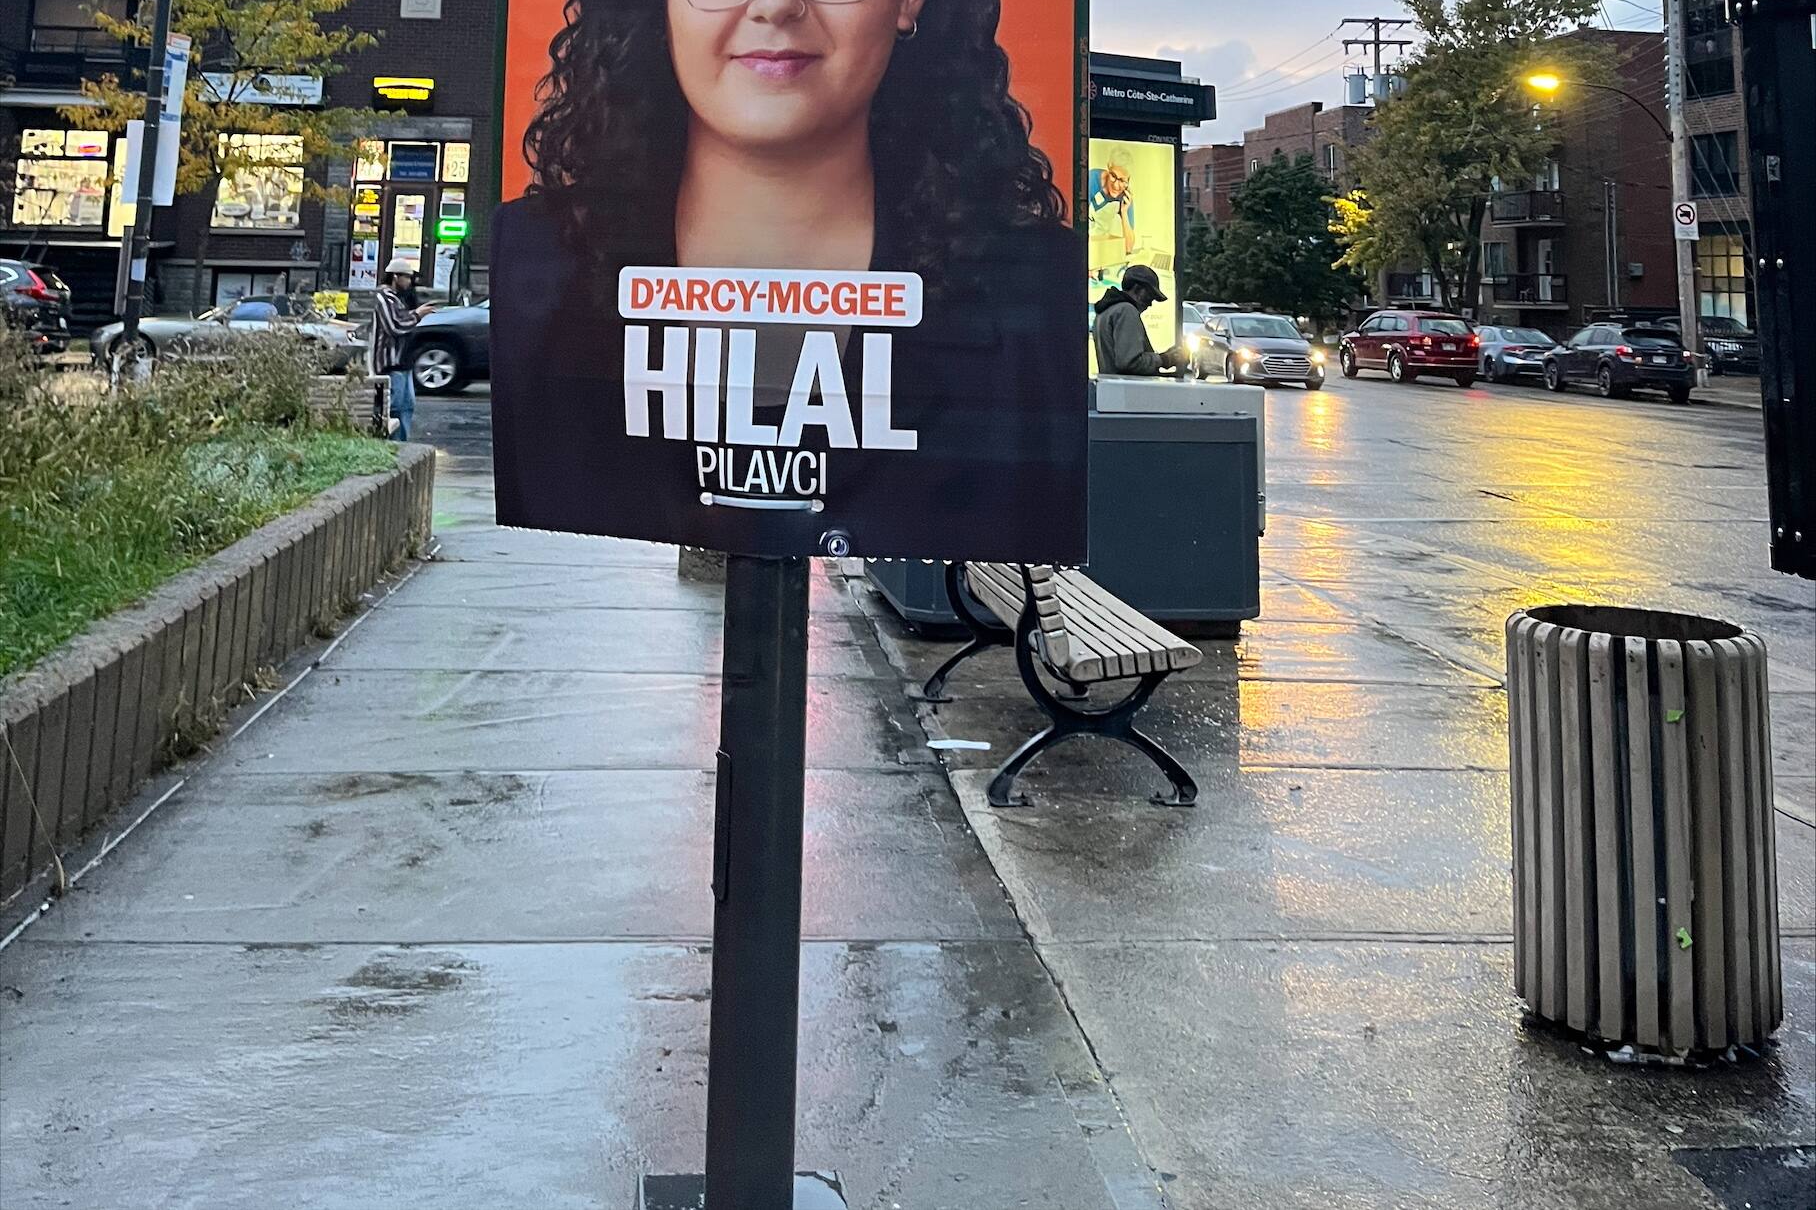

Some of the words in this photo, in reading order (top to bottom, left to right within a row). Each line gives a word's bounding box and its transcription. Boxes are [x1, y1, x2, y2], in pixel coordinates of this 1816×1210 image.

[630, 277, 907, 318] D'ARCY-MCGEE
[624, 324, 919, 451] HILAL
[695, 445, 827, 496] PILAVCI
